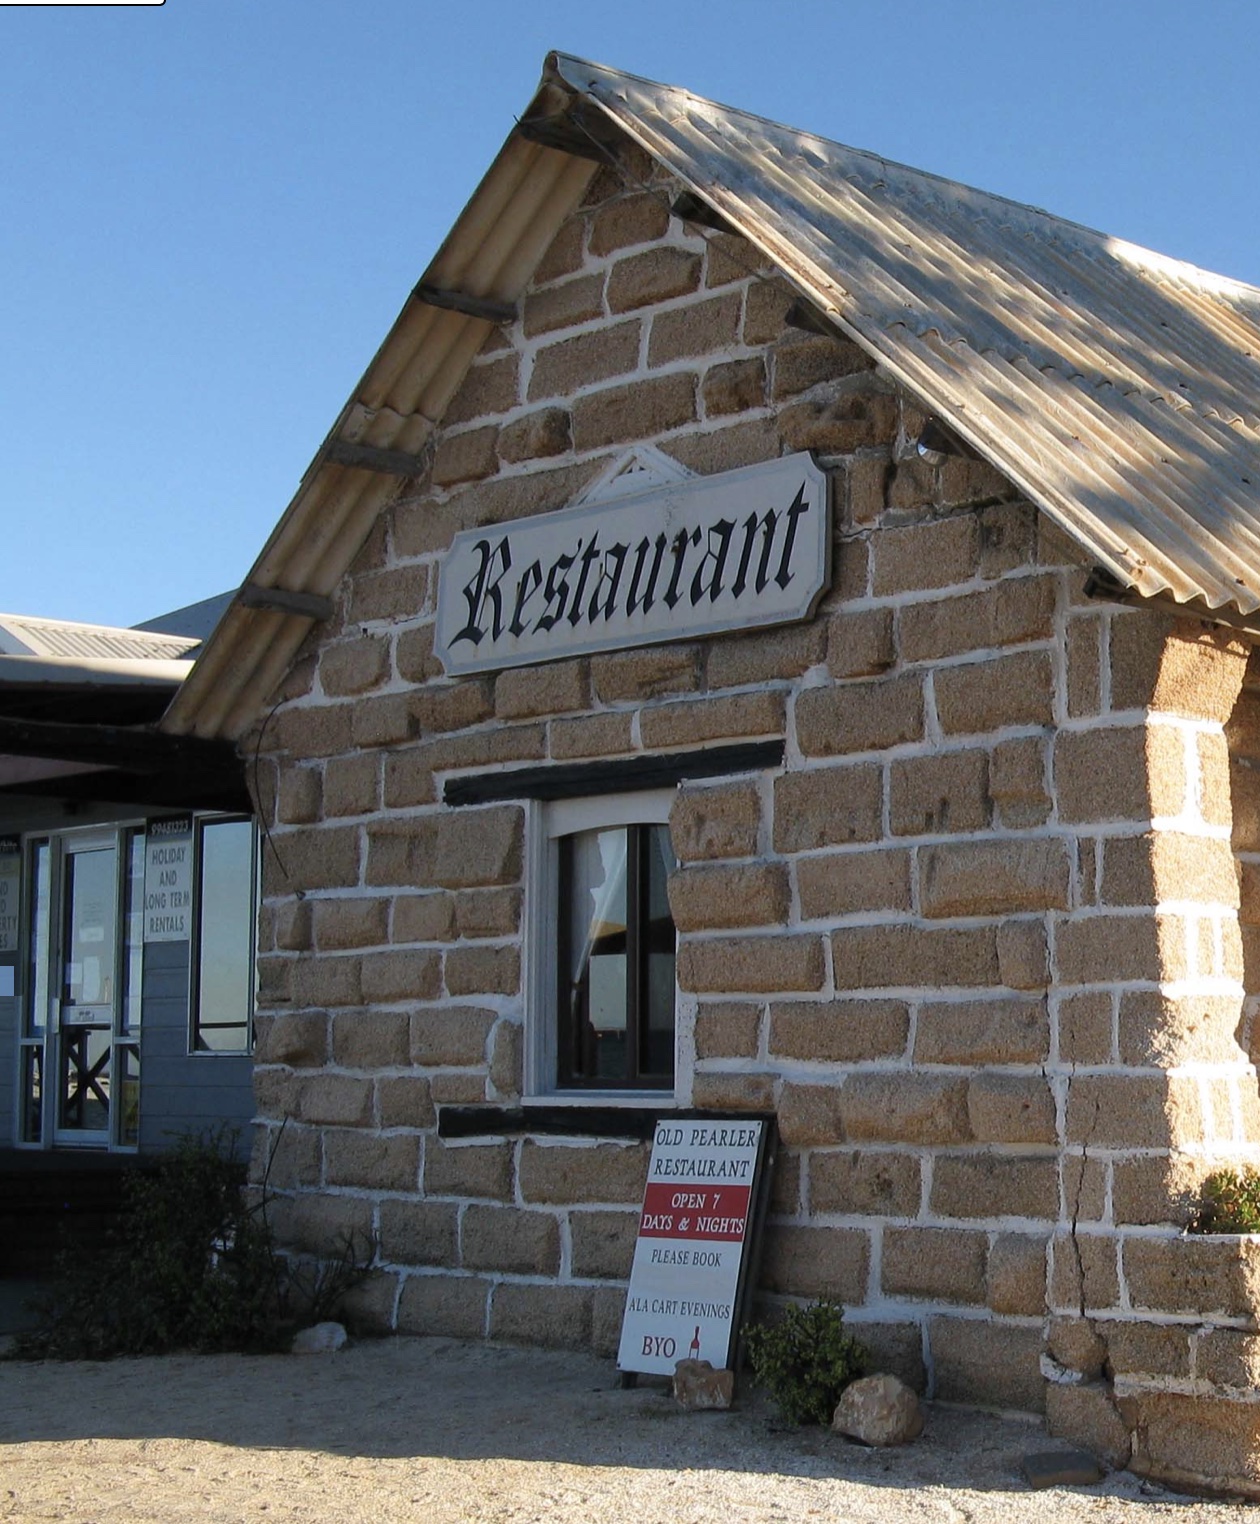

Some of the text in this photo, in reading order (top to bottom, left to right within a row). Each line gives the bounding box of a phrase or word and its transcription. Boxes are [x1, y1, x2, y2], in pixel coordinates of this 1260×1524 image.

[447, 480, 810, 649] Restaurant
[151, 847, 186, 865] HOLIDAY
[159, 870, 178, 887] AND
[145, 890, 190, 910] LONG TERM
[150, 915, 185, 933] RENTALS
[656, 1128, 756, 1148] OLD PEARLER
[654, 1158, 750, 1178] RESTAURANT
[671, 1193, 721, 1210] OPEN 7
[642, 1214, 744, 1234] DAYS & NIGHTS
[651, 1249, 722, 1267] PLEASE BOOK
[652, 1299, 679, 1315] CART
[680, 1301, 731, 1319] EVENINGS
[641, 1335, 676, 1358] BYO
